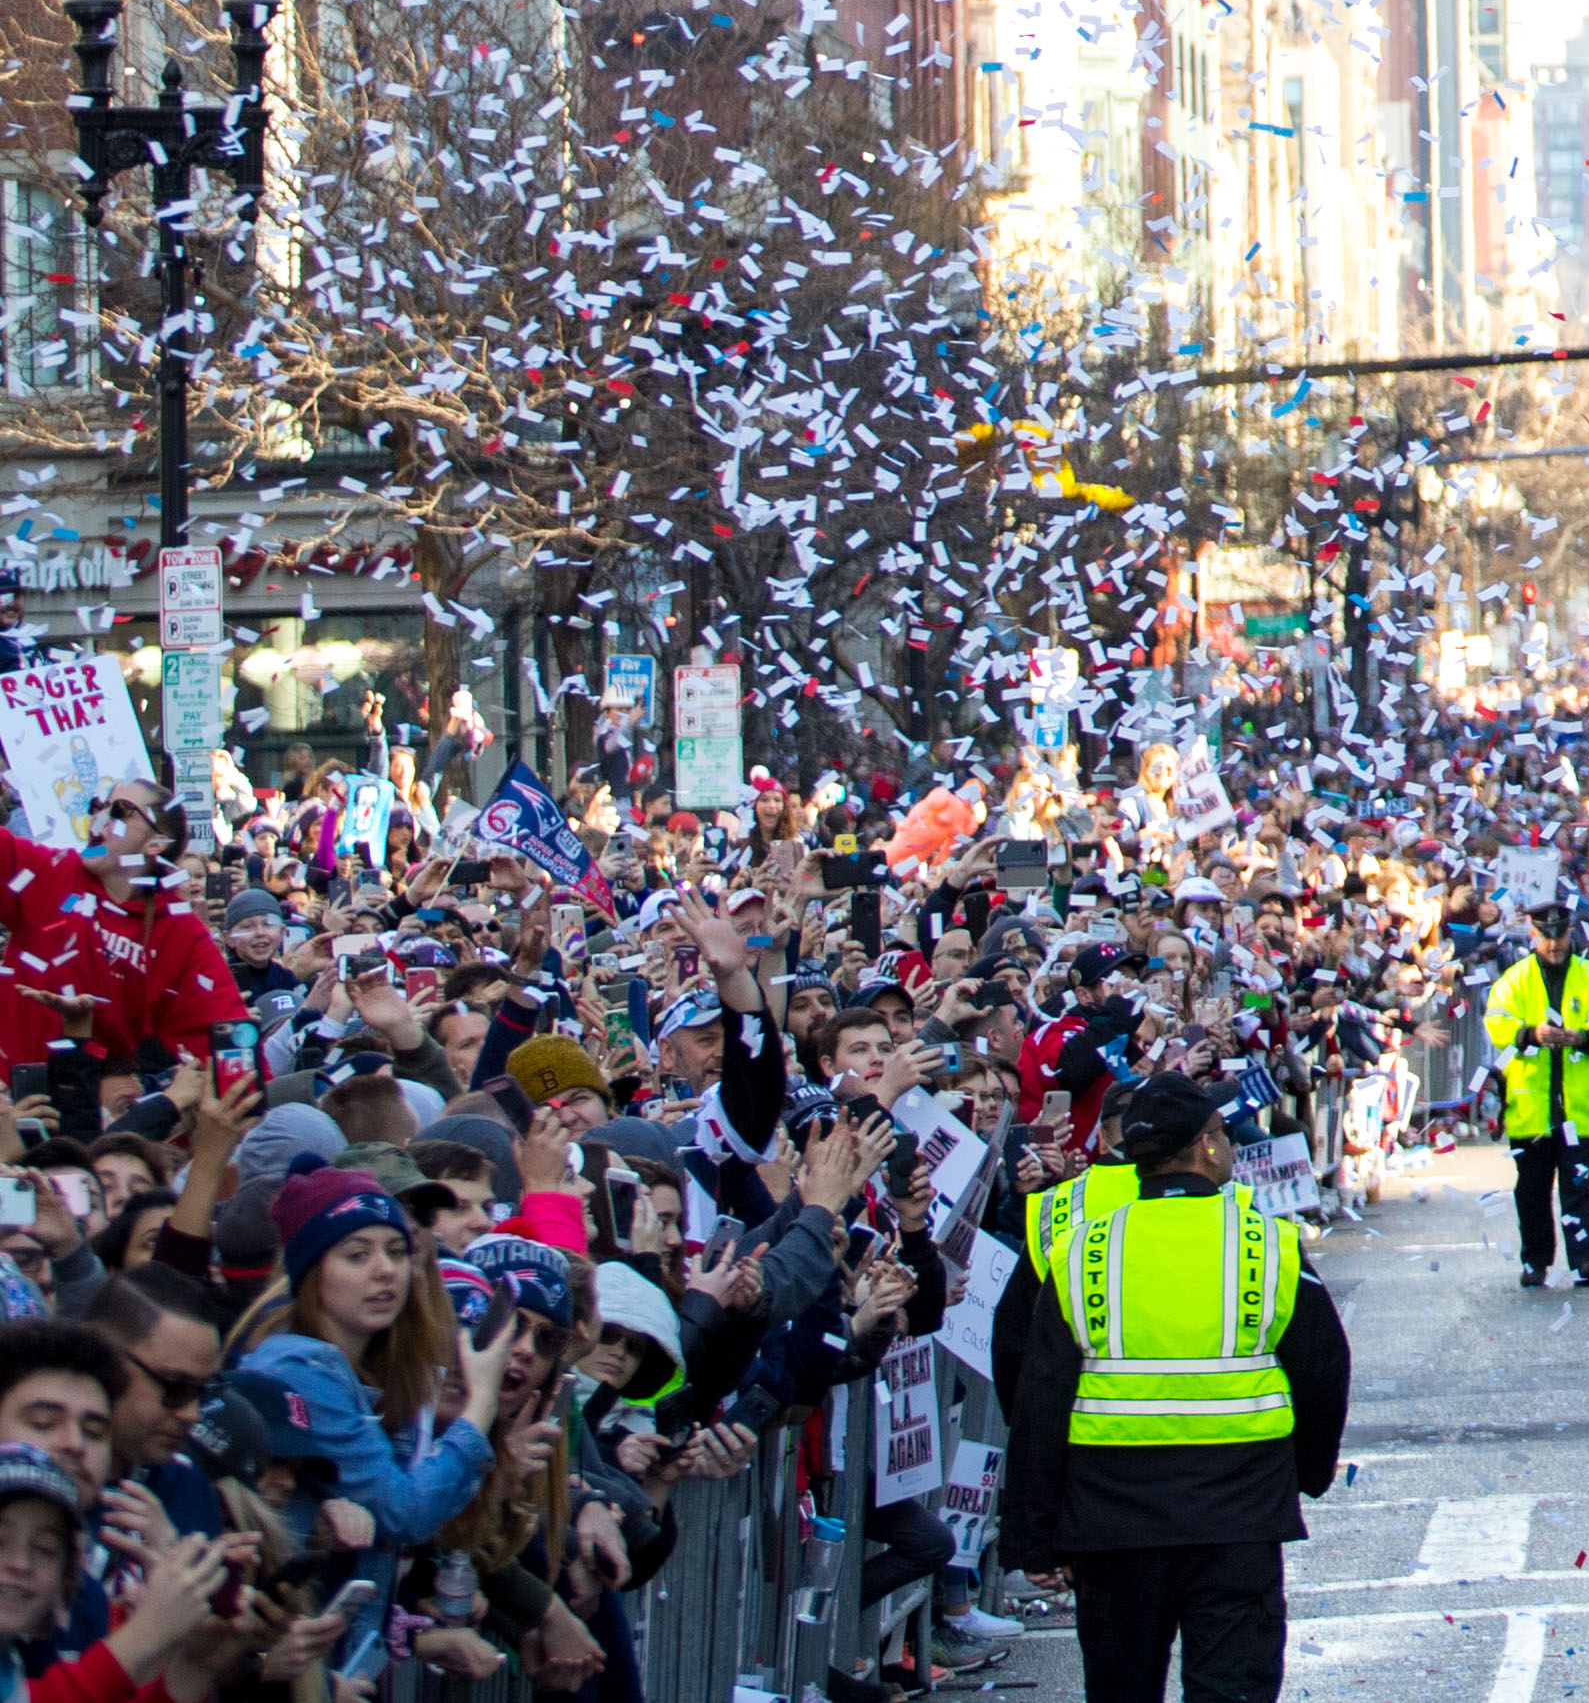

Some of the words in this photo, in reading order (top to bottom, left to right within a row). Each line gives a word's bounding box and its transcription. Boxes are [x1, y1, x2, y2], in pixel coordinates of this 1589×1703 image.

[1, 664, 102, 709] ROGER
[167, 658, 177, 677] 2
[184, 710, 202, 721] PAY
[542, 1071, 559, 1092] B
[472, 1240, 568, 1271] PATRIOTS
[1243, 1217, 1262, 1327] POLICE
[1086, 1220, 1107, 1330] BOSTON
[887, 1424, 933, 1475] AGAIN!
